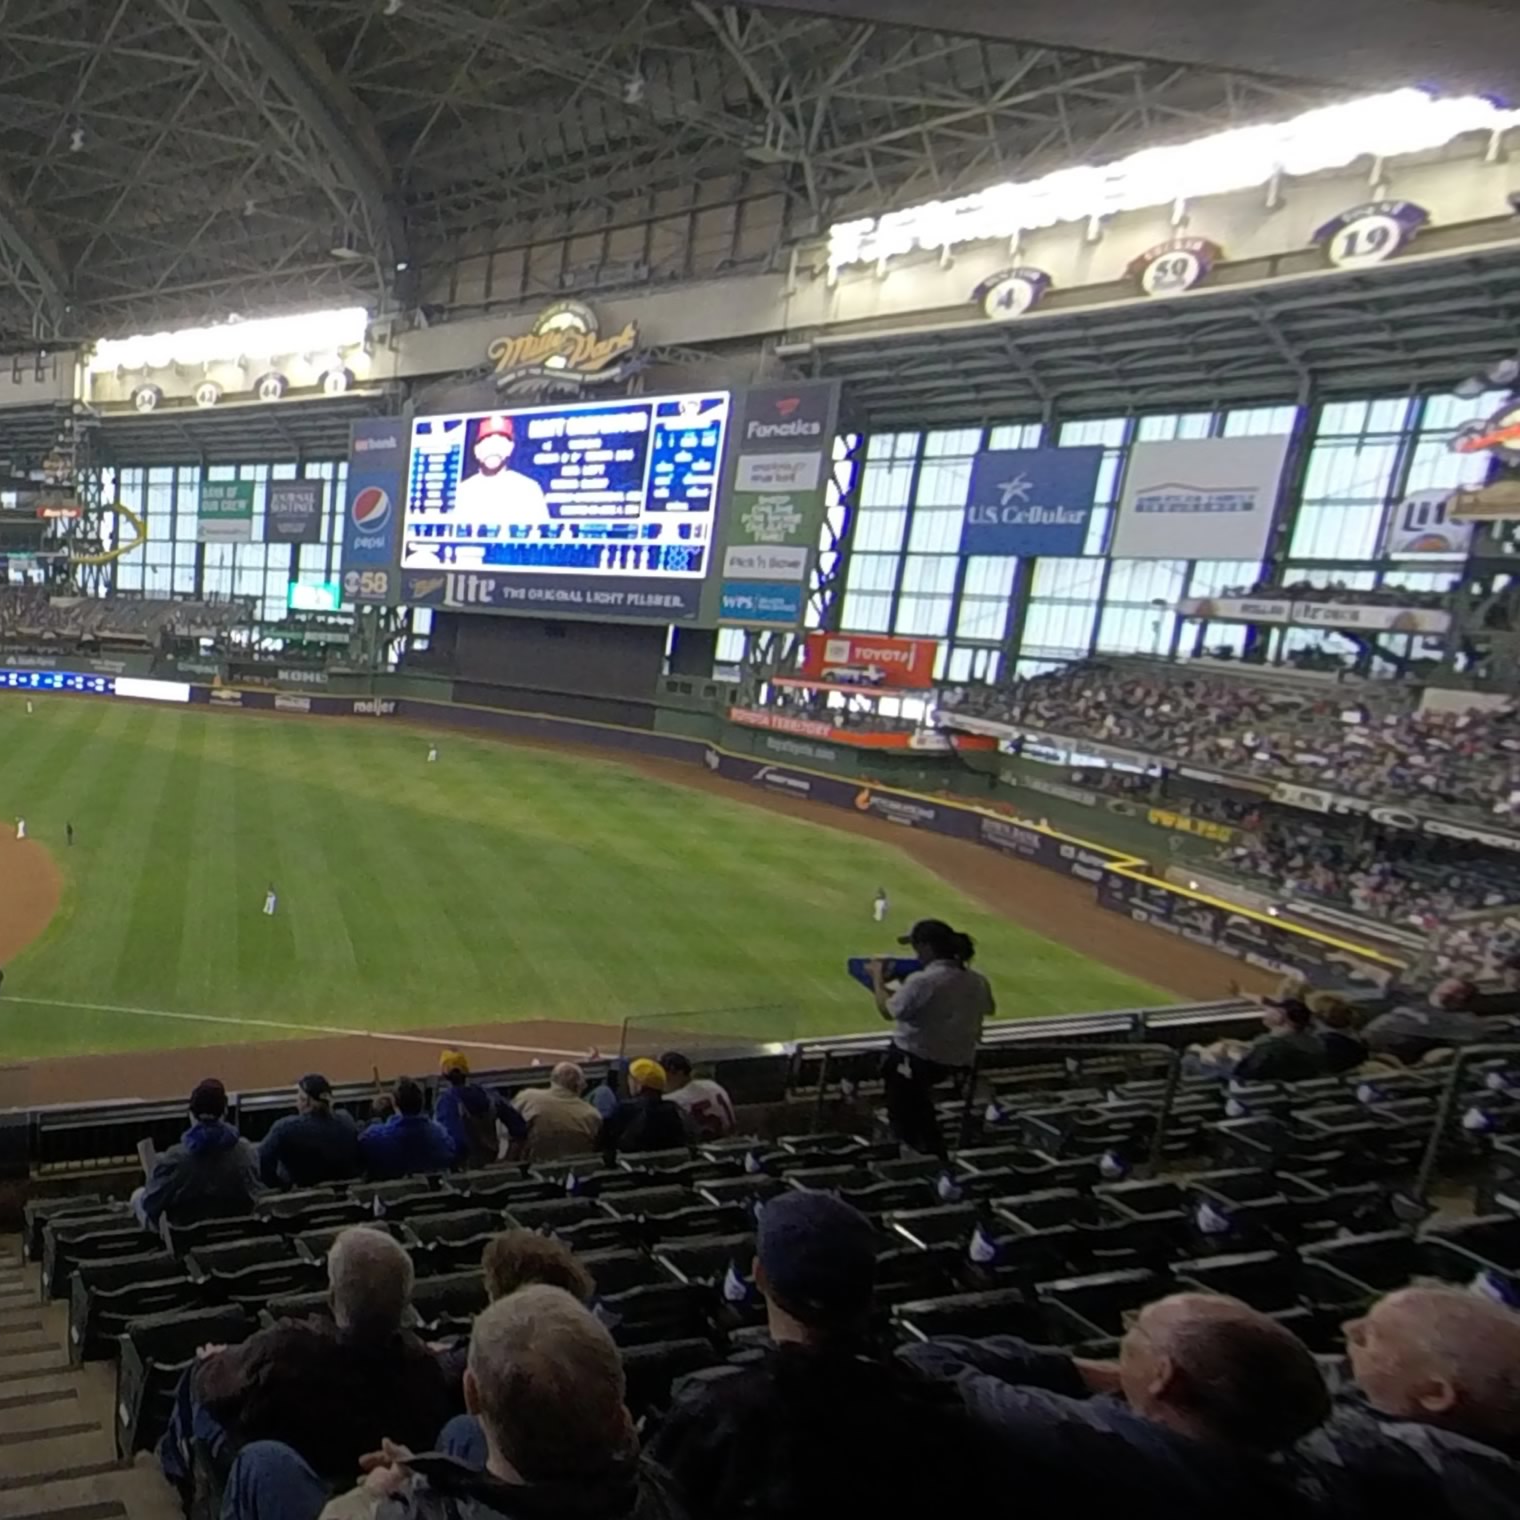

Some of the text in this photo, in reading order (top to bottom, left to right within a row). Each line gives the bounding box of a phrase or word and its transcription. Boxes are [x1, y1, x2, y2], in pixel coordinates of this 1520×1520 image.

[1344, 227, 1391, 257] 19
[996, 288, 1014, 310] 4
[747, 419, 820, 439] Fanatics
[1002, 505, 1086, 524] Cellular
[1402, 501, 1464, 532] Lit
[354, 536, 385, 549] pepsi
[360, 571, 388, 593] 58
[443, 572, 496, 608] Lite
[502, 587, 525, 599] THE
[586, 591, 623, 605] LIGHT
[722, 596, 753, 609] WPS
[854, 646, 908, 663] TOYOTA
[353, 700, 395, 715] meijer
